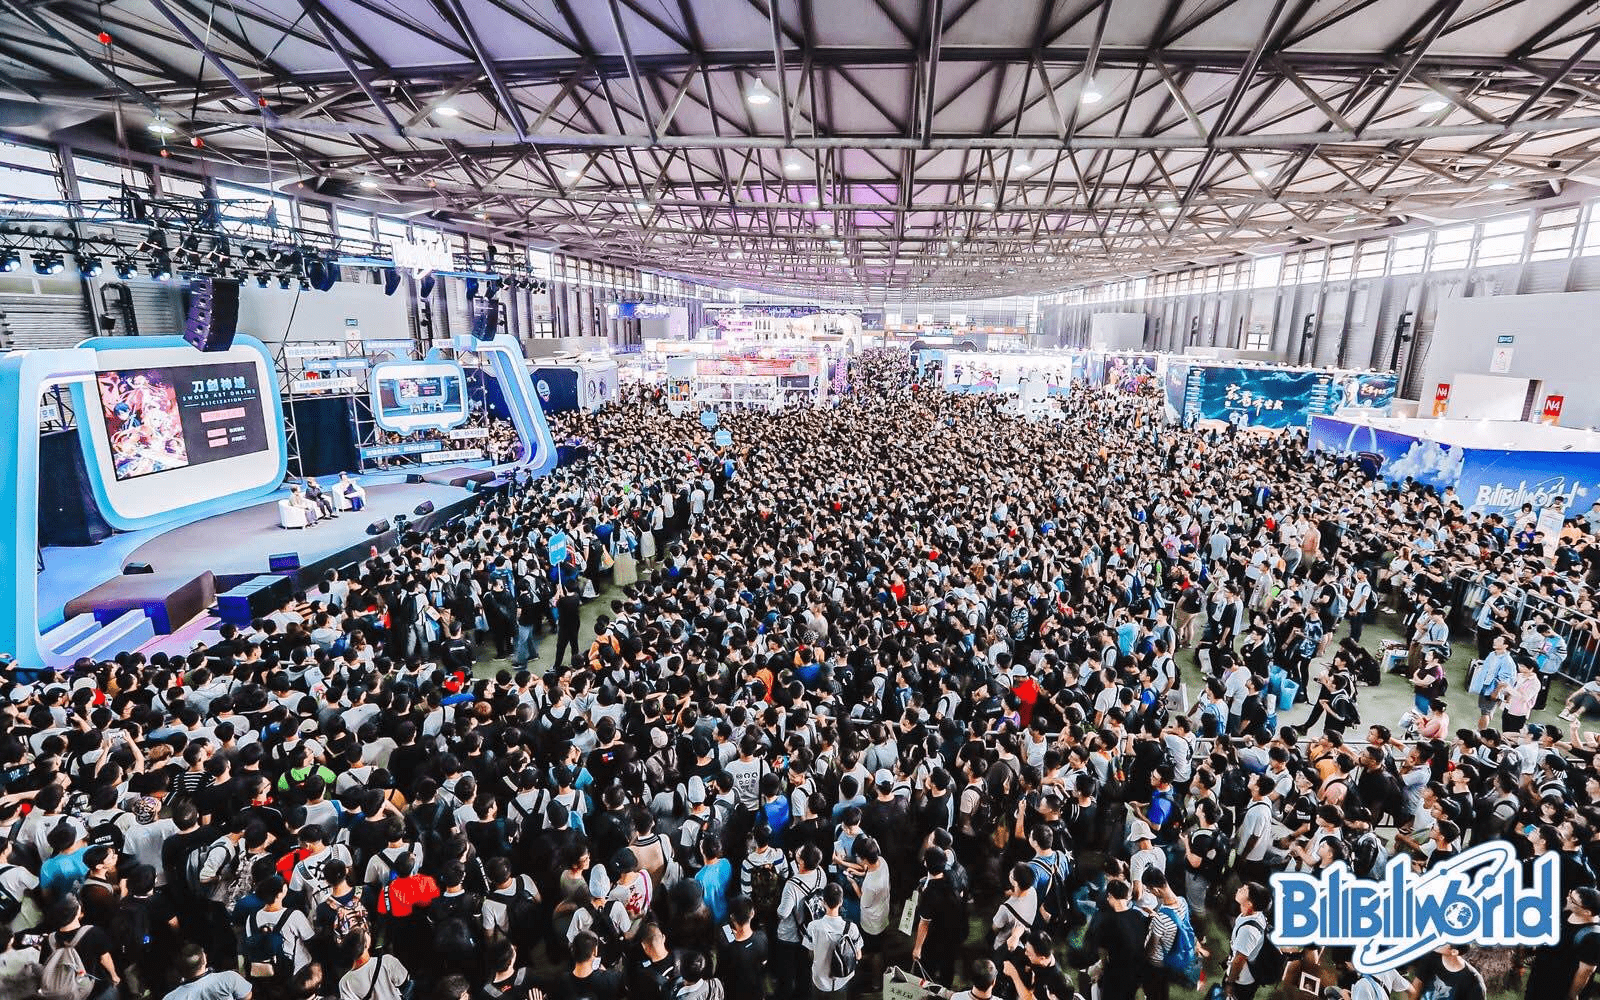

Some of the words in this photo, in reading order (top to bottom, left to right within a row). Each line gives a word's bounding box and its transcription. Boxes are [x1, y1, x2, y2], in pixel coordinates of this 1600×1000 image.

[1436, 387, 1448, 397] N4
[201, 397, 242, 406] ALICIZATION
[1545, 399, 1561, 411] N4
